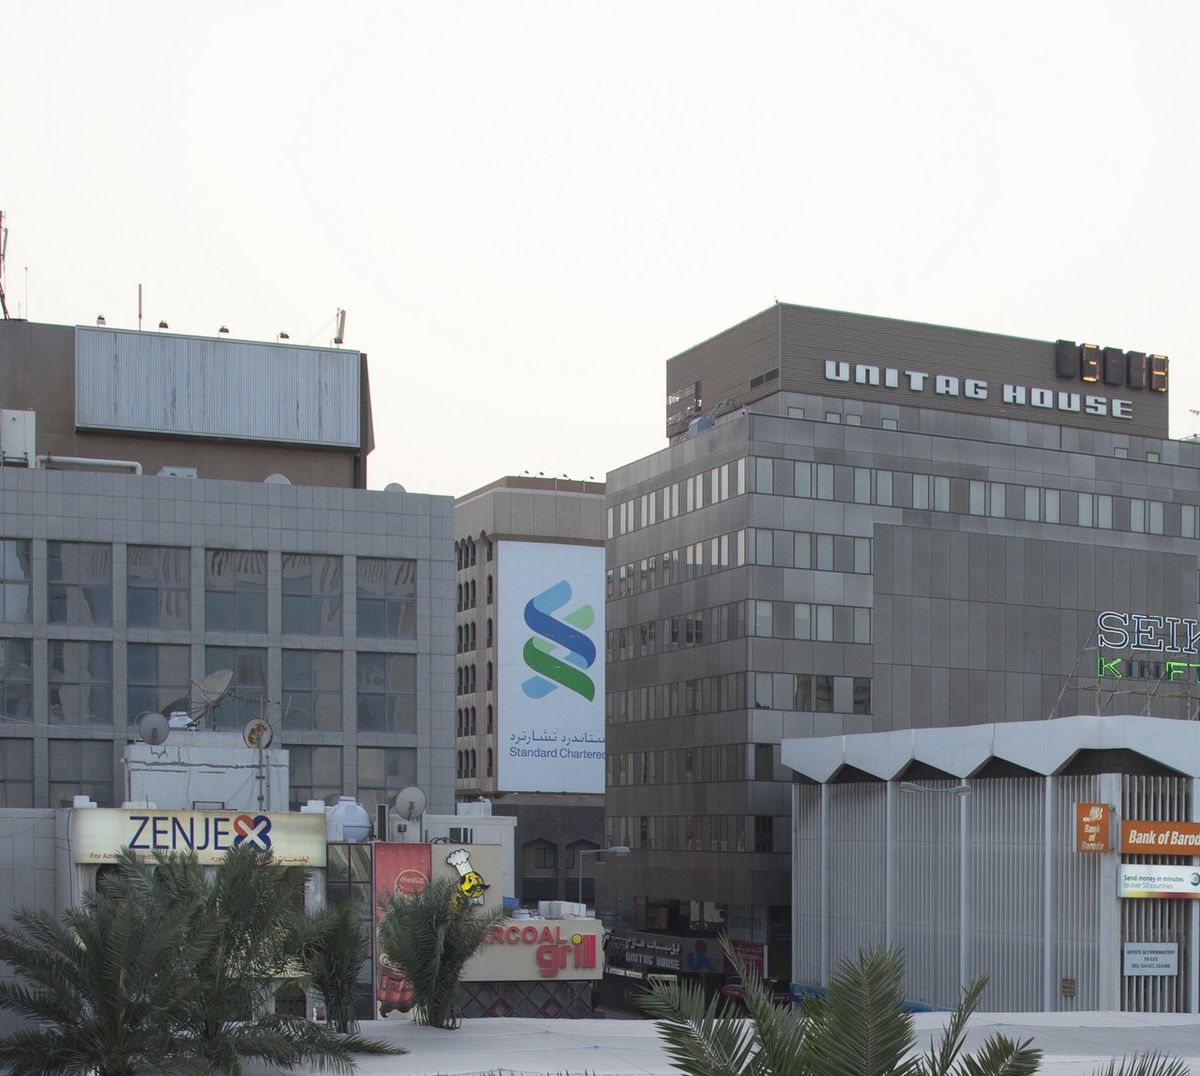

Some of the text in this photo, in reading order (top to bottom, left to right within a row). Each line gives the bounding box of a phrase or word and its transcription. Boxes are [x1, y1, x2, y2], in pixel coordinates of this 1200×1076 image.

[824, 360, 1133, 419] UNITAG HOUSE
[509, 746, 557, 758] Standard
[1084, 824, 1101, 833] Bank
[1088, 833, 1096, 842] of
[1128, 829, 1155, 845] Bank
[1157, 830, 1169, 845] of
[1081, 841, 1104, 850] Baroda
[480, 924, 568, 945] RCOAL
[536, 933, 596, 977] grill
[625, 952, 681, 970] UNITAG HOUSE
